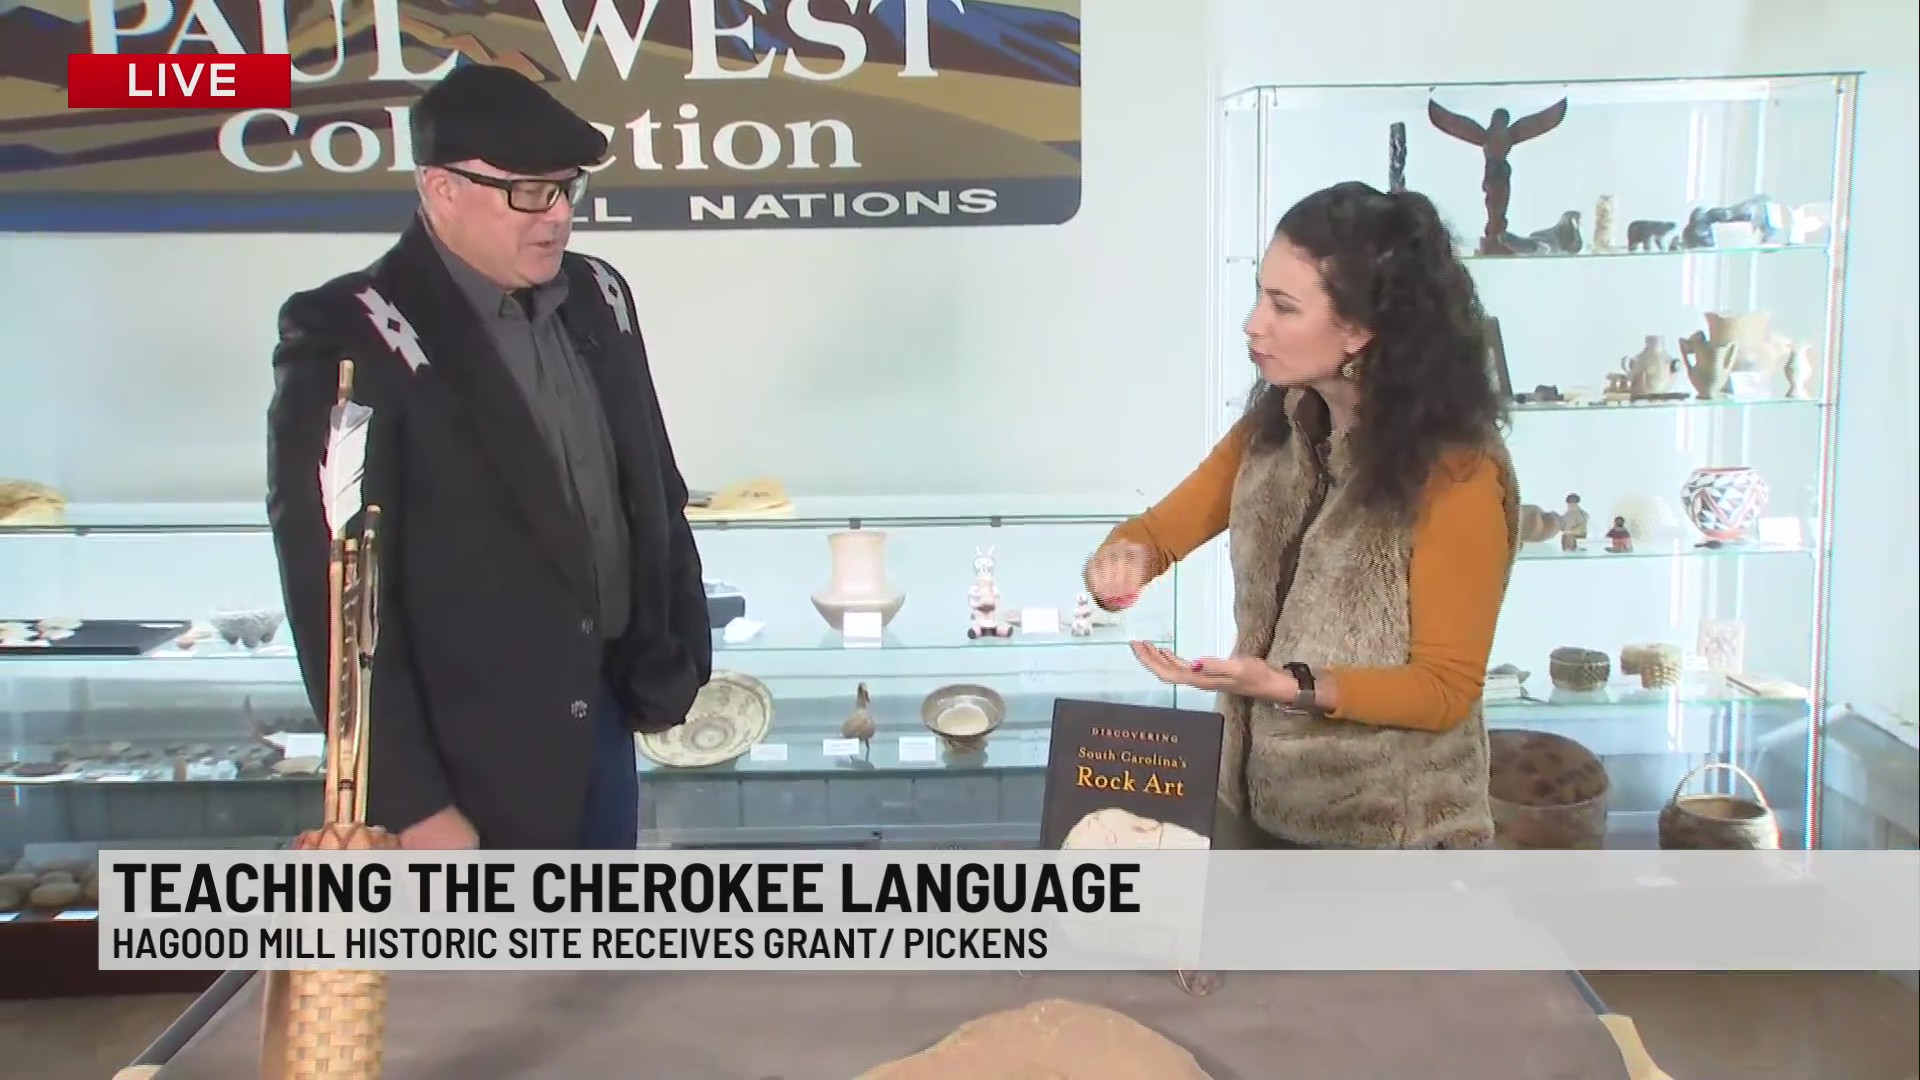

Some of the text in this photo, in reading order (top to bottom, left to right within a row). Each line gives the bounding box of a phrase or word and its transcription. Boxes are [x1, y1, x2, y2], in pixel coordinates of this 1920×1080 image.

[88, 0, 966, 83] PAUL WEST
[690, 188, 998, 221] NATIONS
[1091, 727, 1179, 744] DISCOVERING
[1078, 747, 1189, 769] South Carolina's
[1076, 765, 1185, 797] Rock Art
